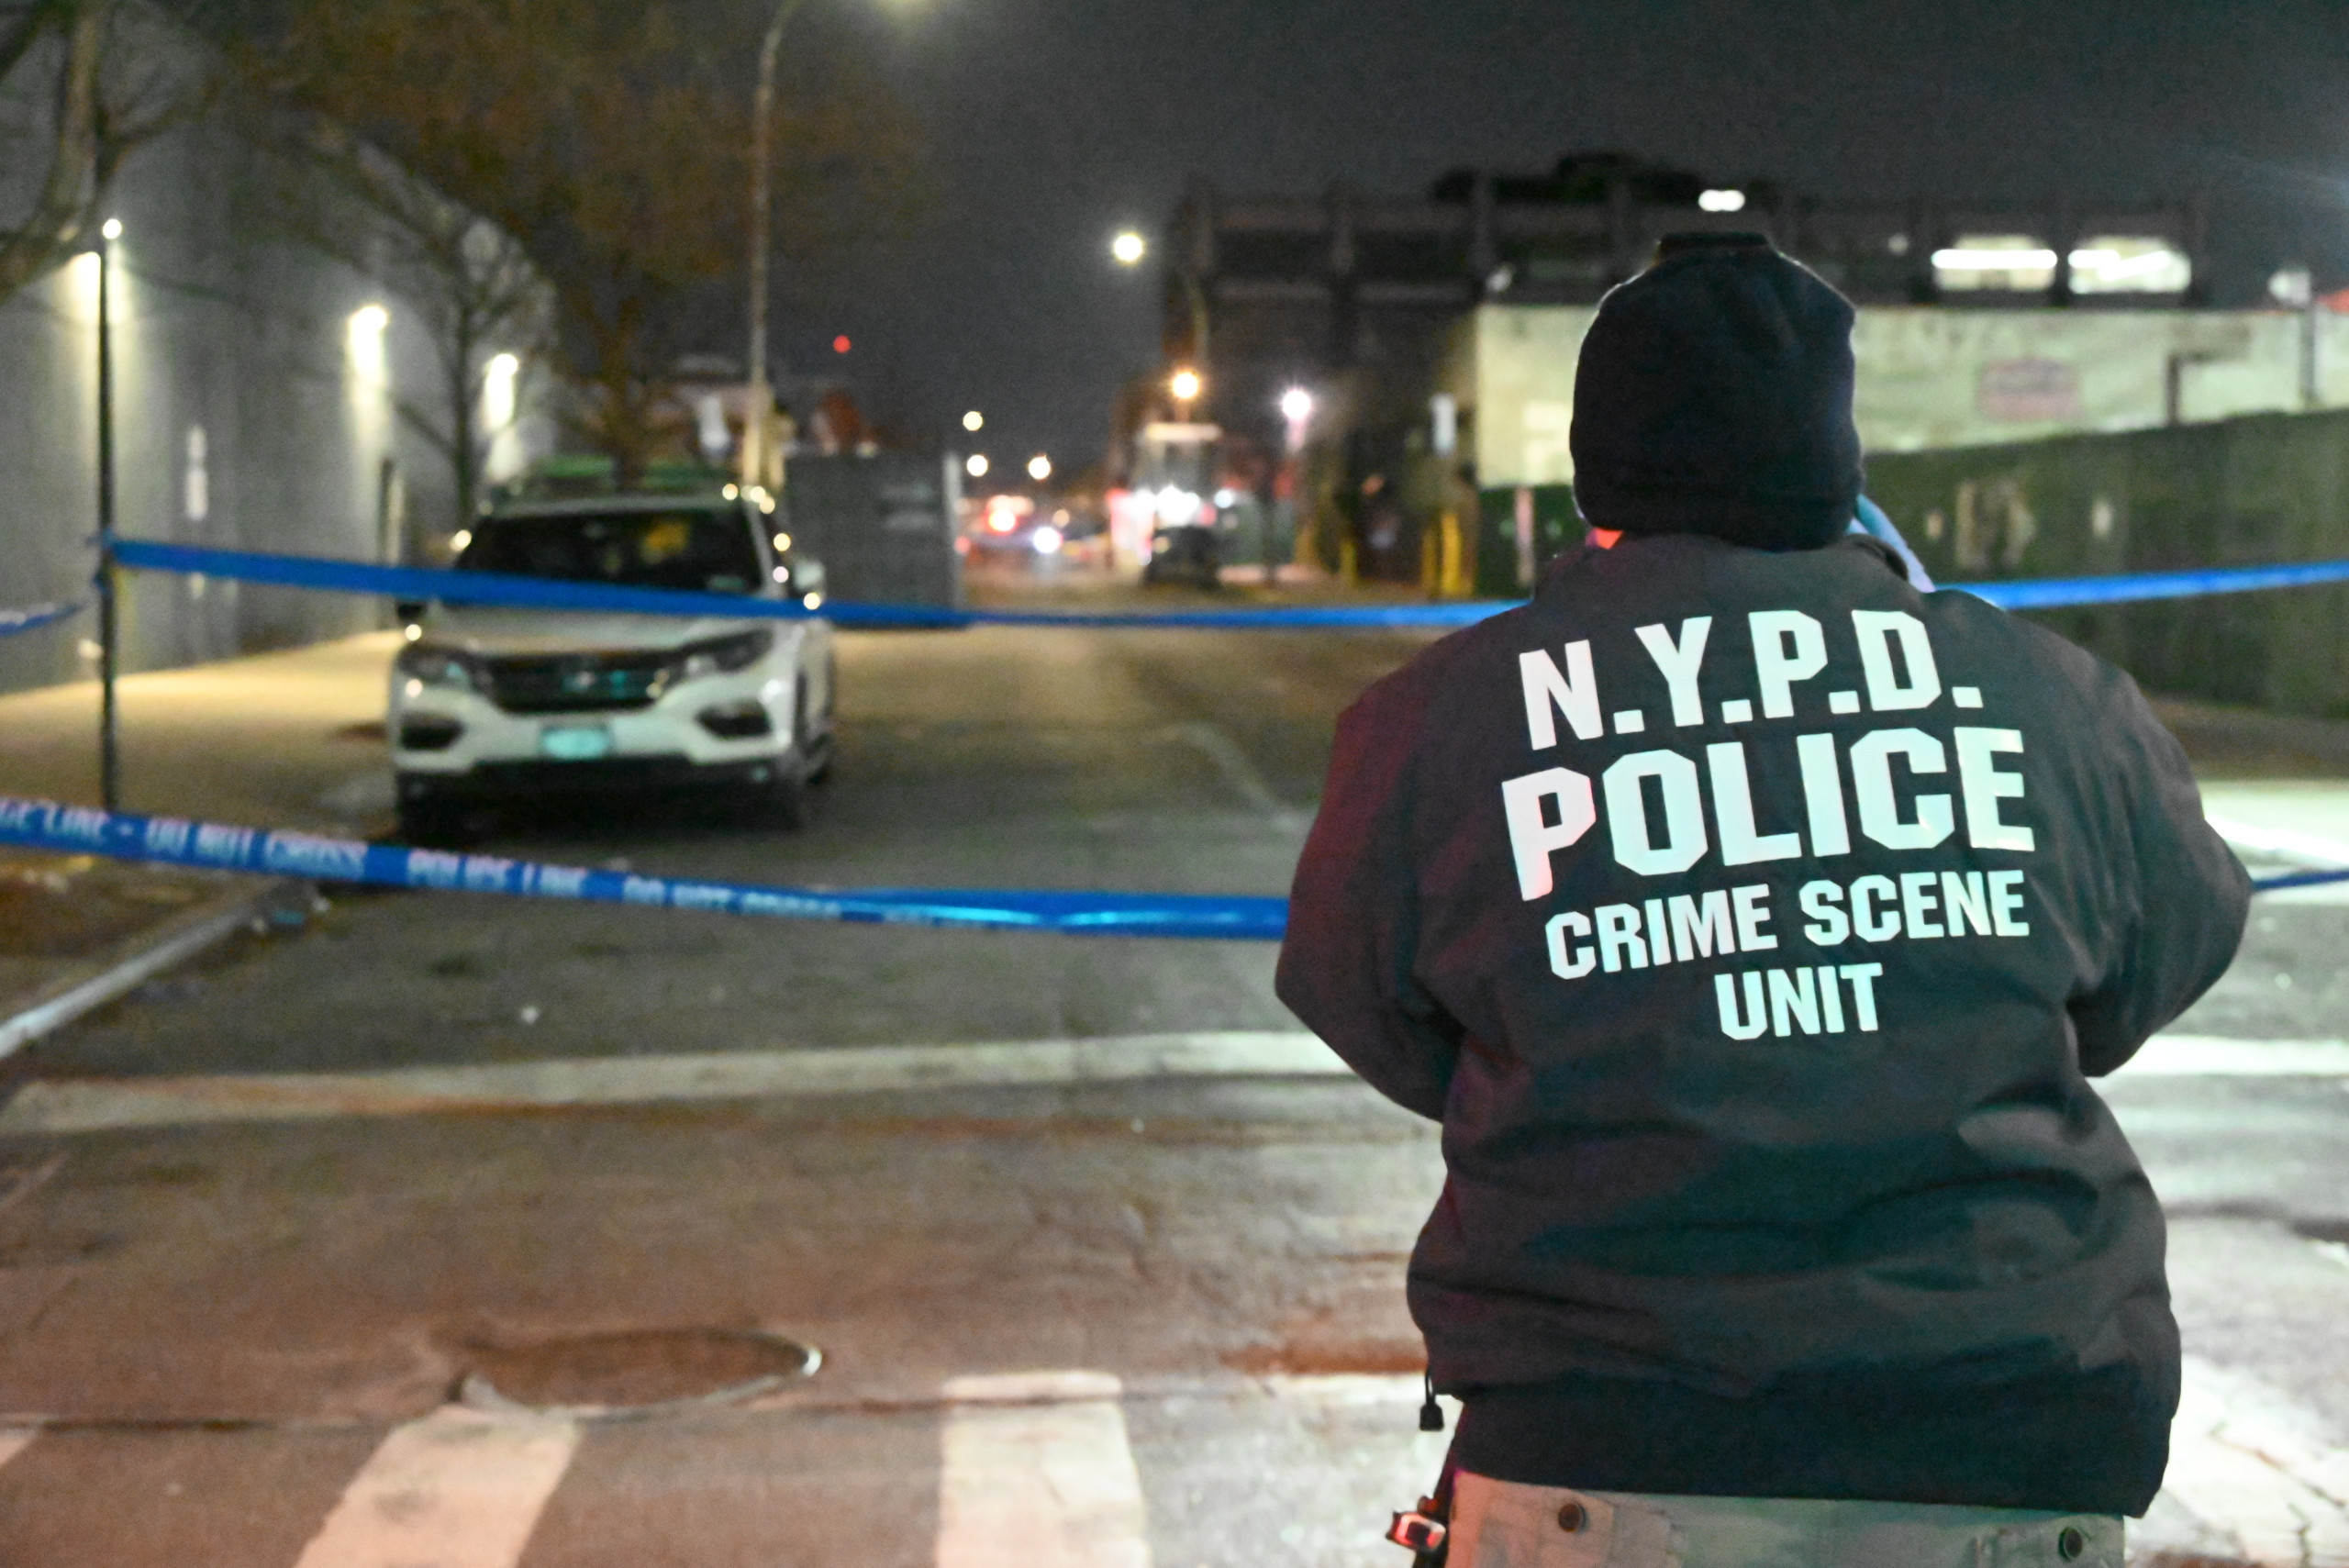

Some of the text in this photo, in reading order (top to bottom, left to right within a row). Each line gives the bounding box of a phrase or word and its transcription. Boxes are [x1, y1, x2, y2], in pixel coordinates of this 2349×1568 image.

[1519, 609, 1984, 750] N.Y.P.D.
[1502, 727, 2035, 901] POLICE
[1545, 870, 2030, 980] CRIME SCENE
[1715, 962, 1883, 1040] UNIT
